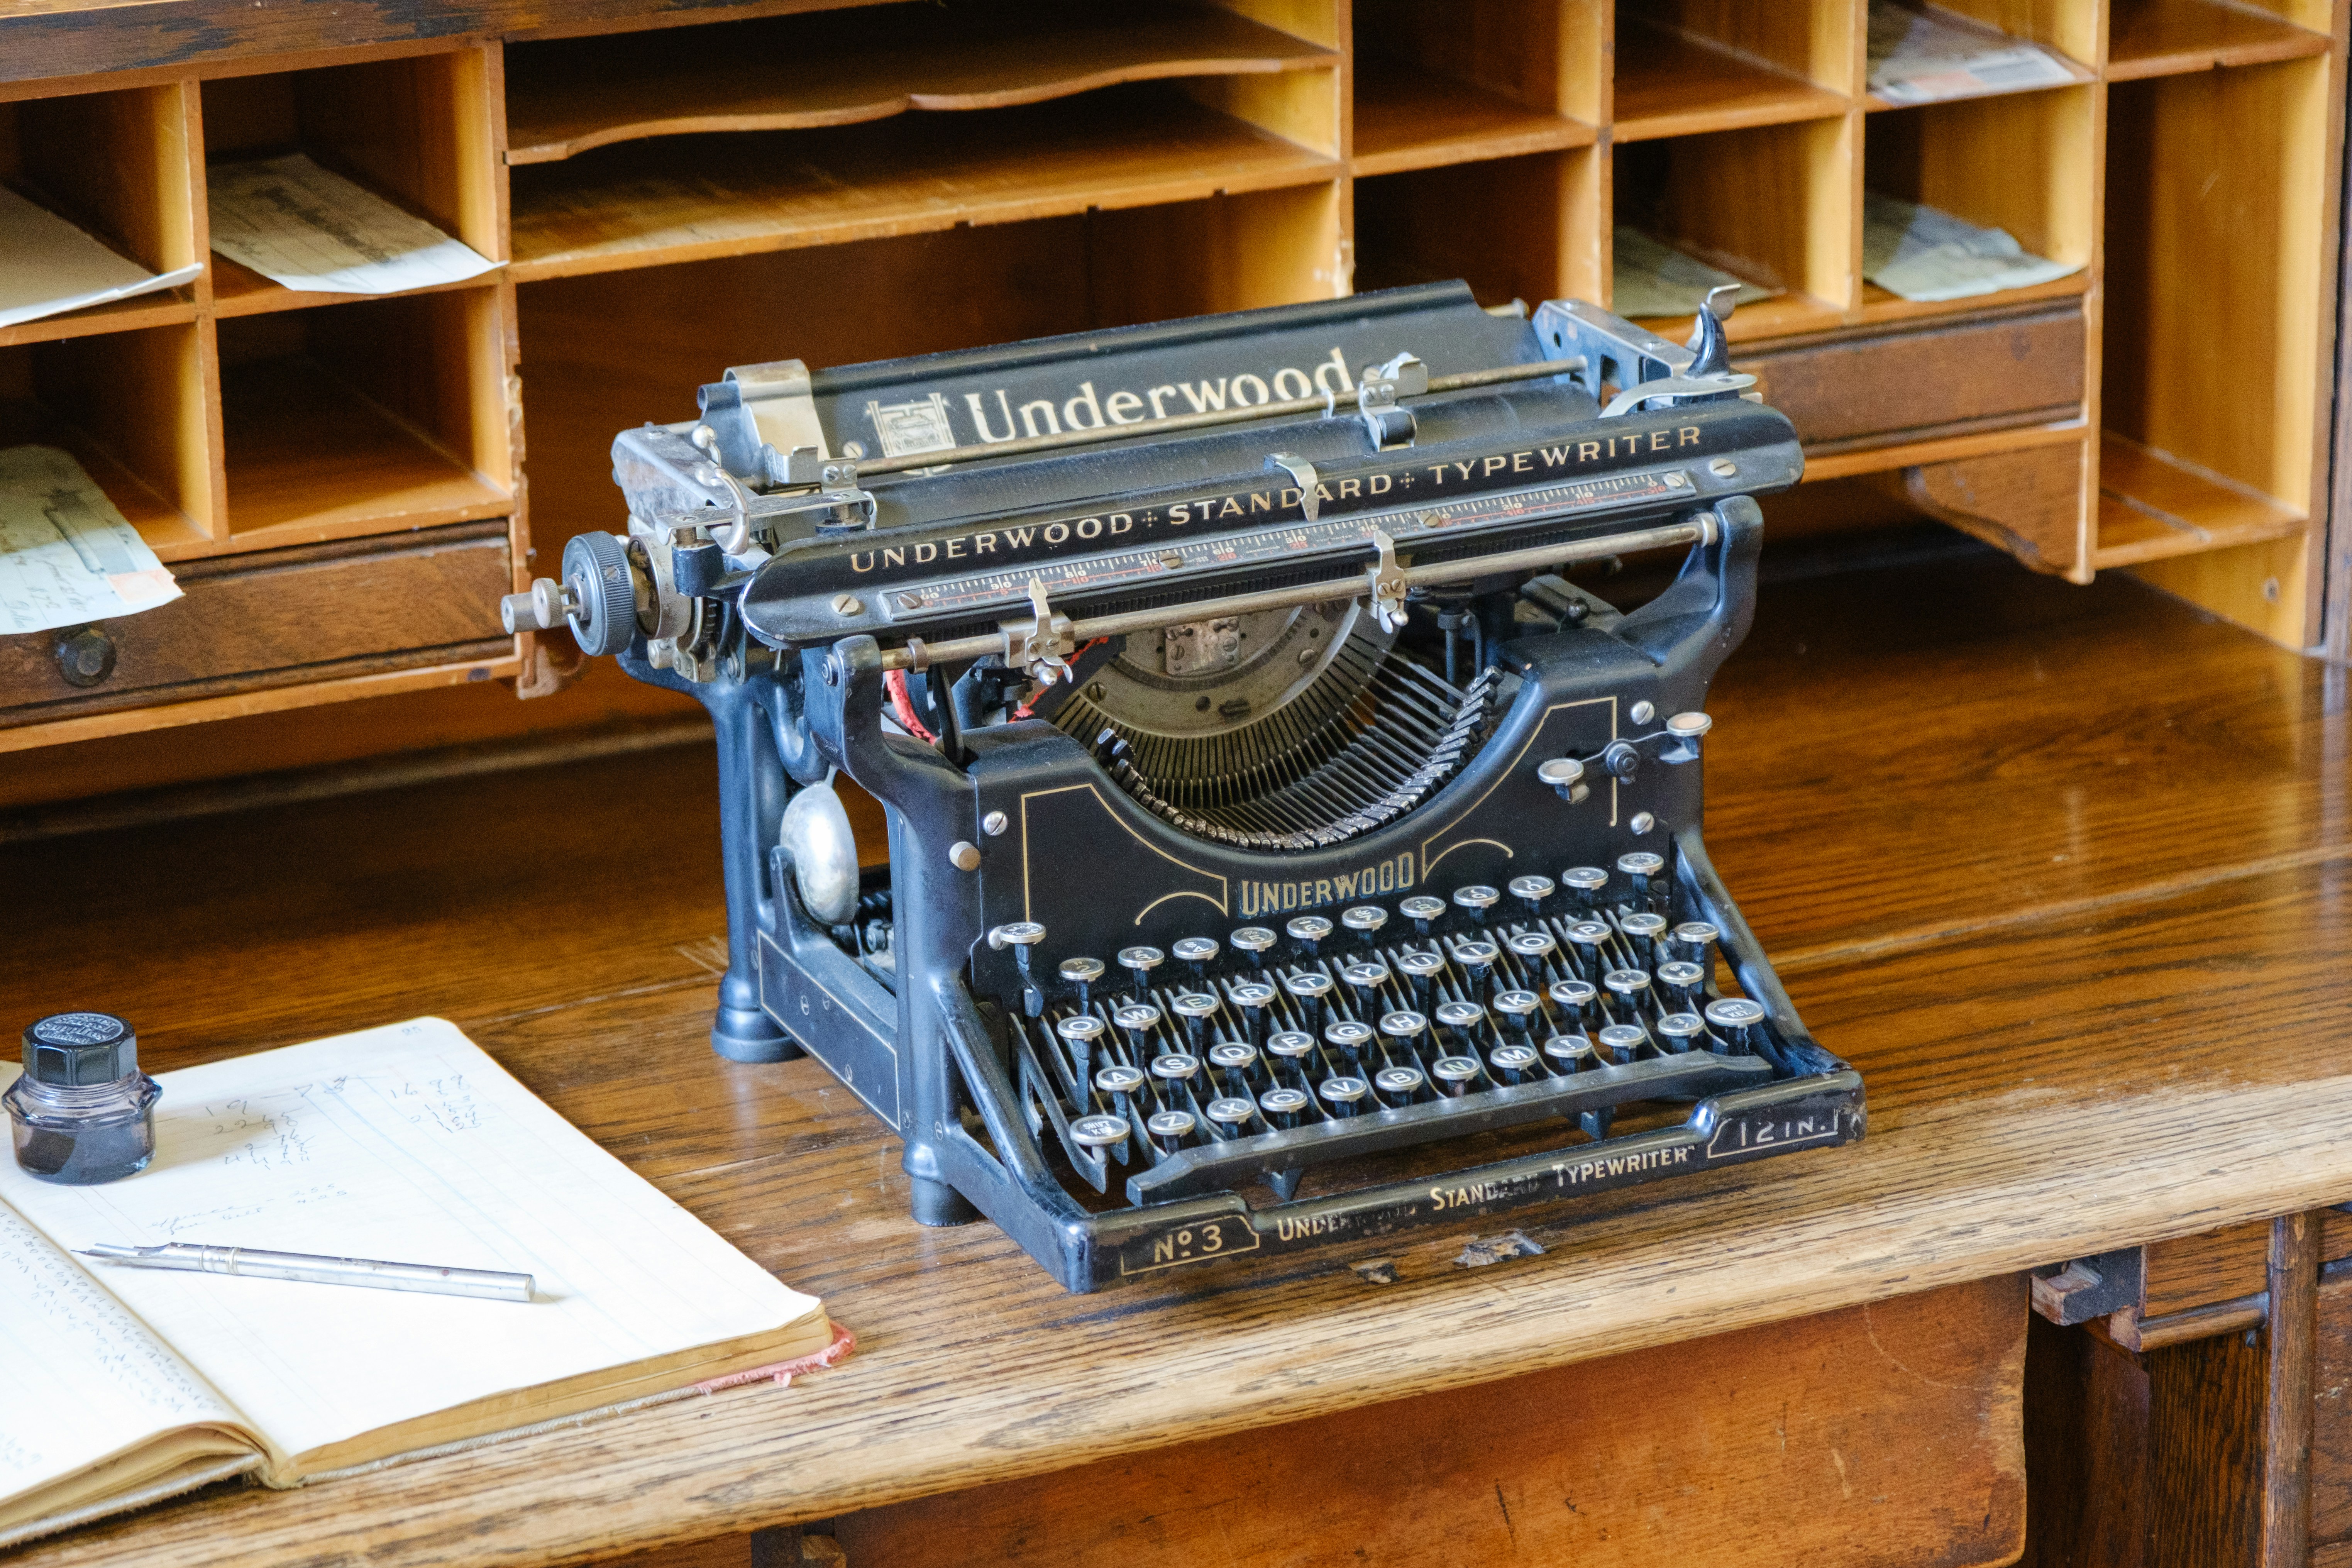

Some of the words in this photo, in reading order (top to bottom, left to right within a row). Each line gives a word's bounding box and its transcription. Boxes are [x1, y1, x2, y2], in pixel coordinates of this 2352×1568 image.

[964, 347, 1354, 443] Underwood
[851, 513, 1133, 572] UNDERWOOD
[1169, 473, 1392, 525] STANDARD
[1428, 426, 1700, 484] TYPEWRITER
[1285, 535, 1307, 544] 50
[1212, 547, 1234, 555] 60
[1065, 570, 1087, 578] 80
[991, 581, 1012, 590] 90
[1239, 852, 1414, 918] UNDERWOOD
[1578, 926, 1597, 935] P
[1522, 938, 1545, 947] O
[1468, 947, 1483, 955] I
[1409, 957, 1433, 967] U
[1353, 967, 1373, 977] Y
[1299, 977, 1316, 987] T
[1240, 987, 1264, 998] R
[1561, 986, 1587, 996] L
[1185, 997, 1207, 1008] E
[1504, 994, 1530, 1006] K
[1455, 1006, 1469, 1017] J
[1718, 1004, 1743, 1013] SHIFT
[1123, 1009, 1149, 1021] W
[1068, 1021, 1093, 1031] Q
[1392, 1016, 1416, 1028] H
[1337, 1026, 1362, 1036] G
[1281, 1036, 1299, 1048] F
[1223, 1047, 1246, 1058] D
[1500, 1050, 1529, 1061] M
[1165, 1058, 1186, 1069] S
[1445, 1061, 1469, 1072] N
[1111, 1072, 1131, 1083] A
[1389, 1073, 1411, 1084] B
[1331, 1082, 1351, 1092] V
[1272, 1094, 1296, 1103] C
[1220, 1103, 1243, 1114] X
[1082, 1120, 1111, 1130] SHIFT
[1161, 1116, 1184, 1127] Z
[1741, 1120, 1775, 1147] 12
[1202, 1224, 1223, 1252] 3
